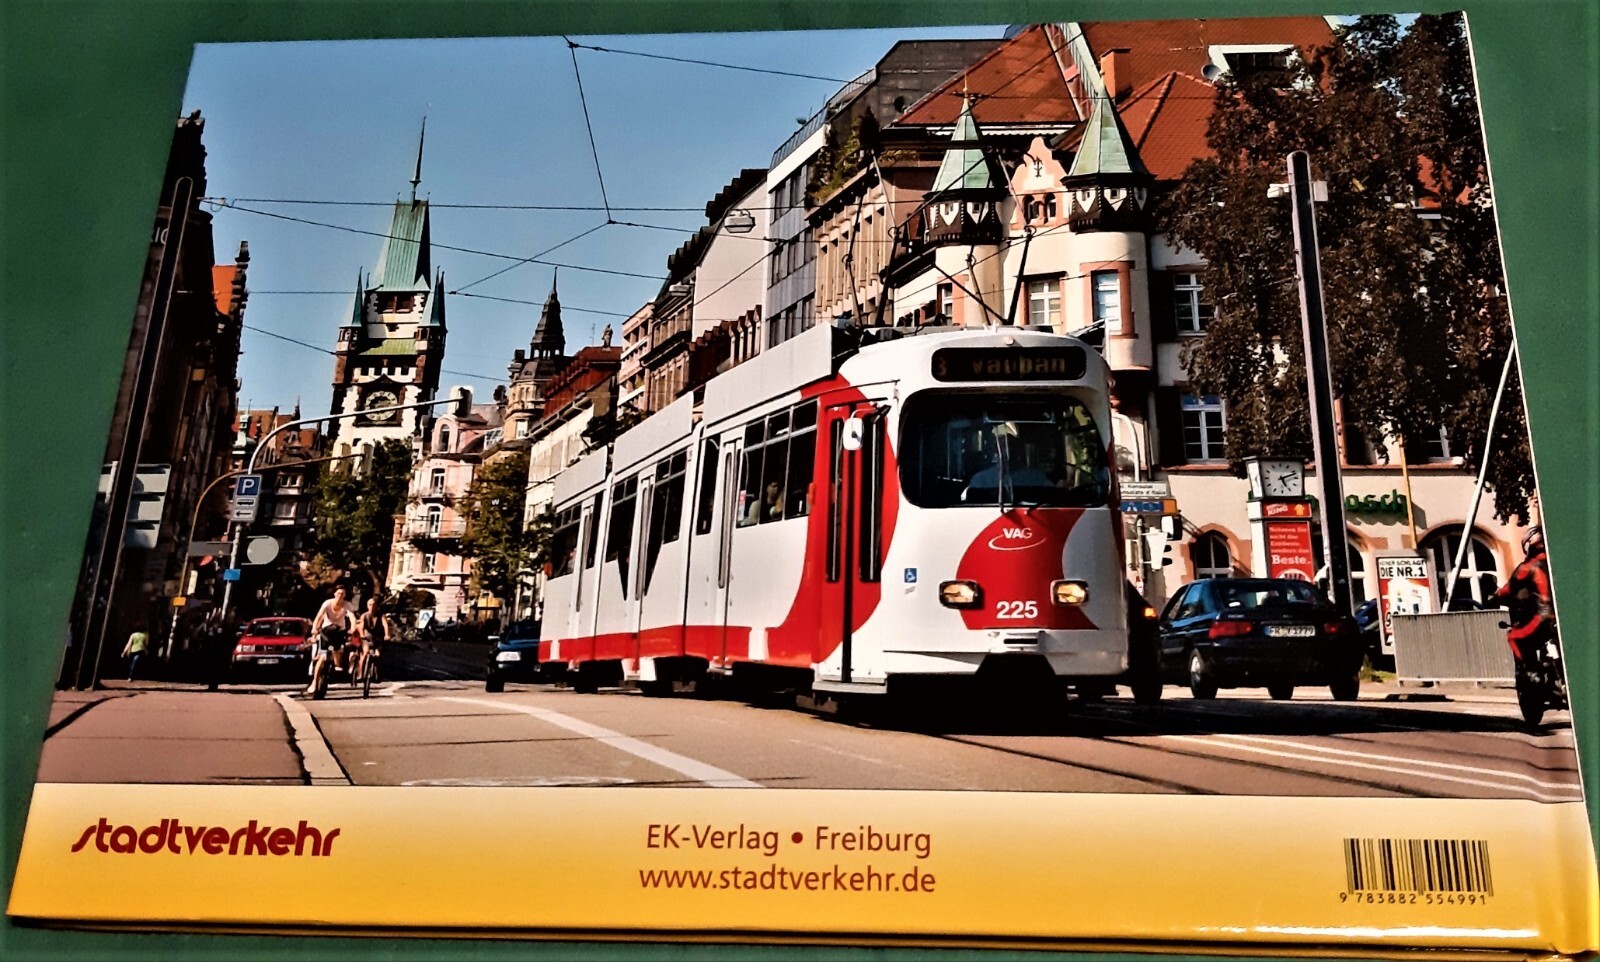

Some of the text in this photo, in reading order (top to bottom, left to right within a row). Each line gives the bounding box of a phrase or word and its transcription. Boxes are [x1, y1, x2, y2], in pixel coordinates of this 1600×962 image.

[242, 478, 255, 494] P
[1003, 528, 1033, 539] VAG
[1271, 554, 1311, 565] Beste.
[1381, 566, 1426, 577] DIE NR.1
[996, 600, 1038, 619] 225
[71, 817, 341, 857] stadtverkehr
[647, 824, 931, 859] EK-Verlag Freiburg
[639, 864, 936, 893] www.stadtverkehr.de
[1339, 892, 1486, 905] 9 783882 554991
